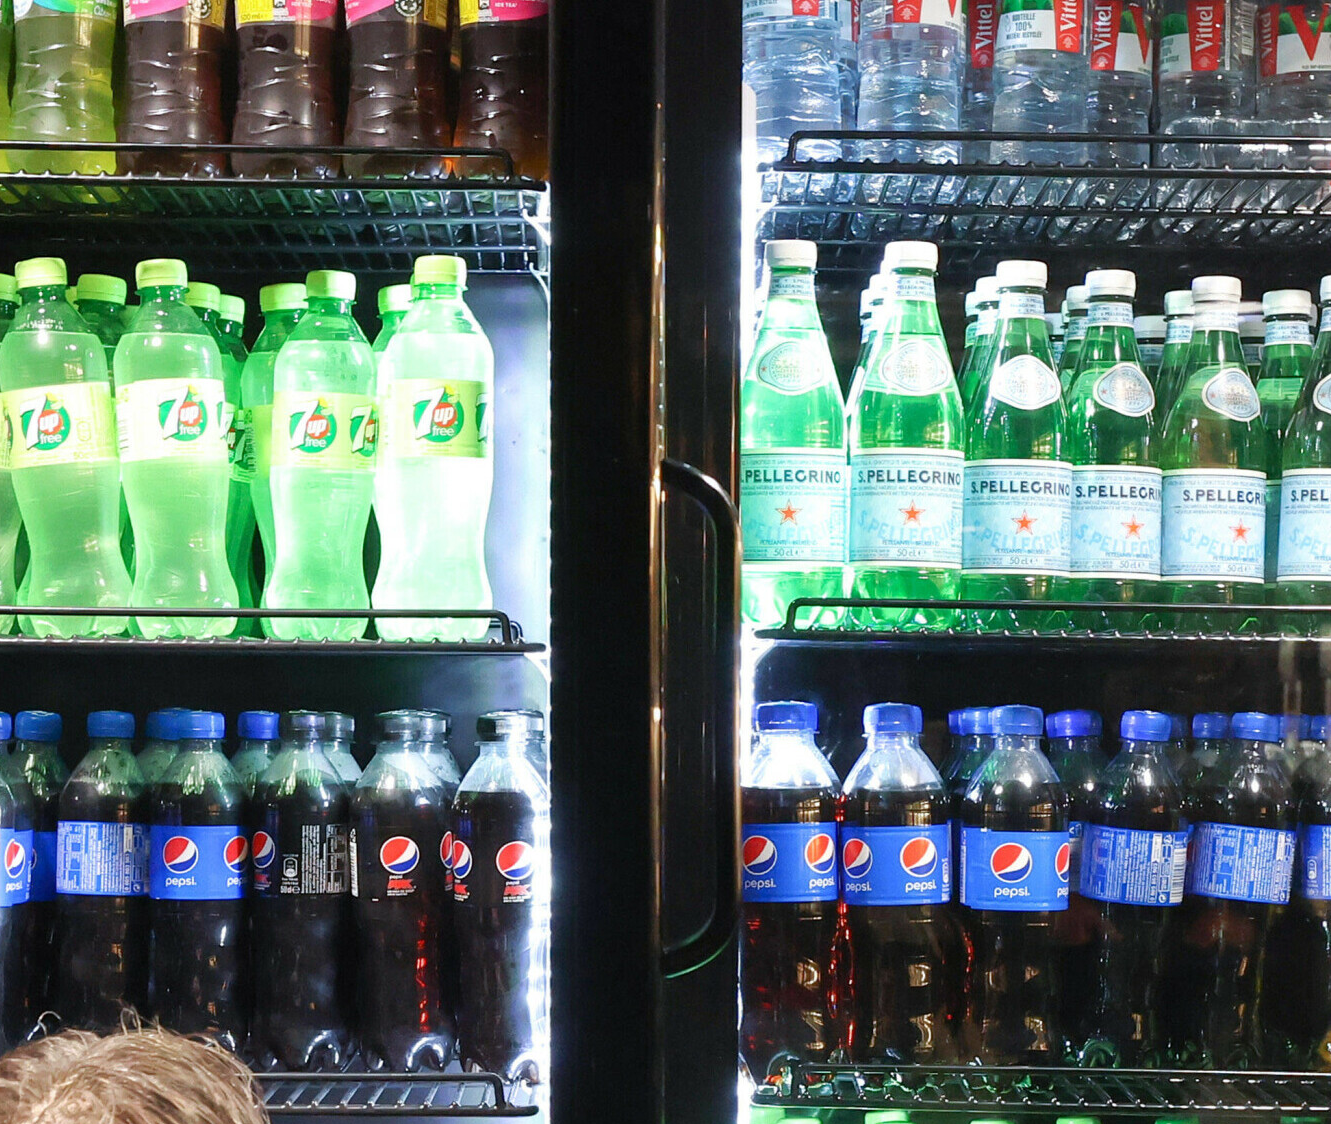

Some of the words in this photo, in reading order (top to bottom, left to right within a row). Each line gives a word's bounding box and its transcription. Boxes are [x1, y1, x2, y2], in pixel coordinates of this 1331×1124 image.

[974, 4, 994, 52] Vittel
[1014, 21, 1033, 31] 100%
[1094, 4, 1112, 52] Vittel
[1195, 4, 1214, 52] Vittel
[159, 388, 189, 440] 7
[180, 408, 200, 426] up
[415, 388, 445, 440] 7
[433, 408, 454, 426] up
[20, 395, 48, 449] 7
[39, 414, 59, 433] up
[290, 400, 319, 450] 7
[307, 418, 328, 437] up
[179, 423, 201, 436] free
[351, 405, 373, 453] 7
[432, 425, 454, 437] free
[39, 433, 62, 445] free
[305, 437, 327, 448] free
[858, 469, 961, 486] S.PELLEGRINO
[971, 480, 1070, 496] S.PELLEGRINO
[773, 549, 784, 557] 50
[896, 549, 907, 557] 50
[1009, 557, 1020, 565] 50
[1119, 560, 1130, 569] 50
[1226, 564, 1237, 572] 50
[165, 876, 195, 888] pepsi
[744, 878, 774, 890] pepsi
[808, 877, 833, 889] pepsi
[845, 881, 869, 892] pepsi
[905, 881, 935, 892] pepsi
[994, 886, 1028, 898] pepsi
